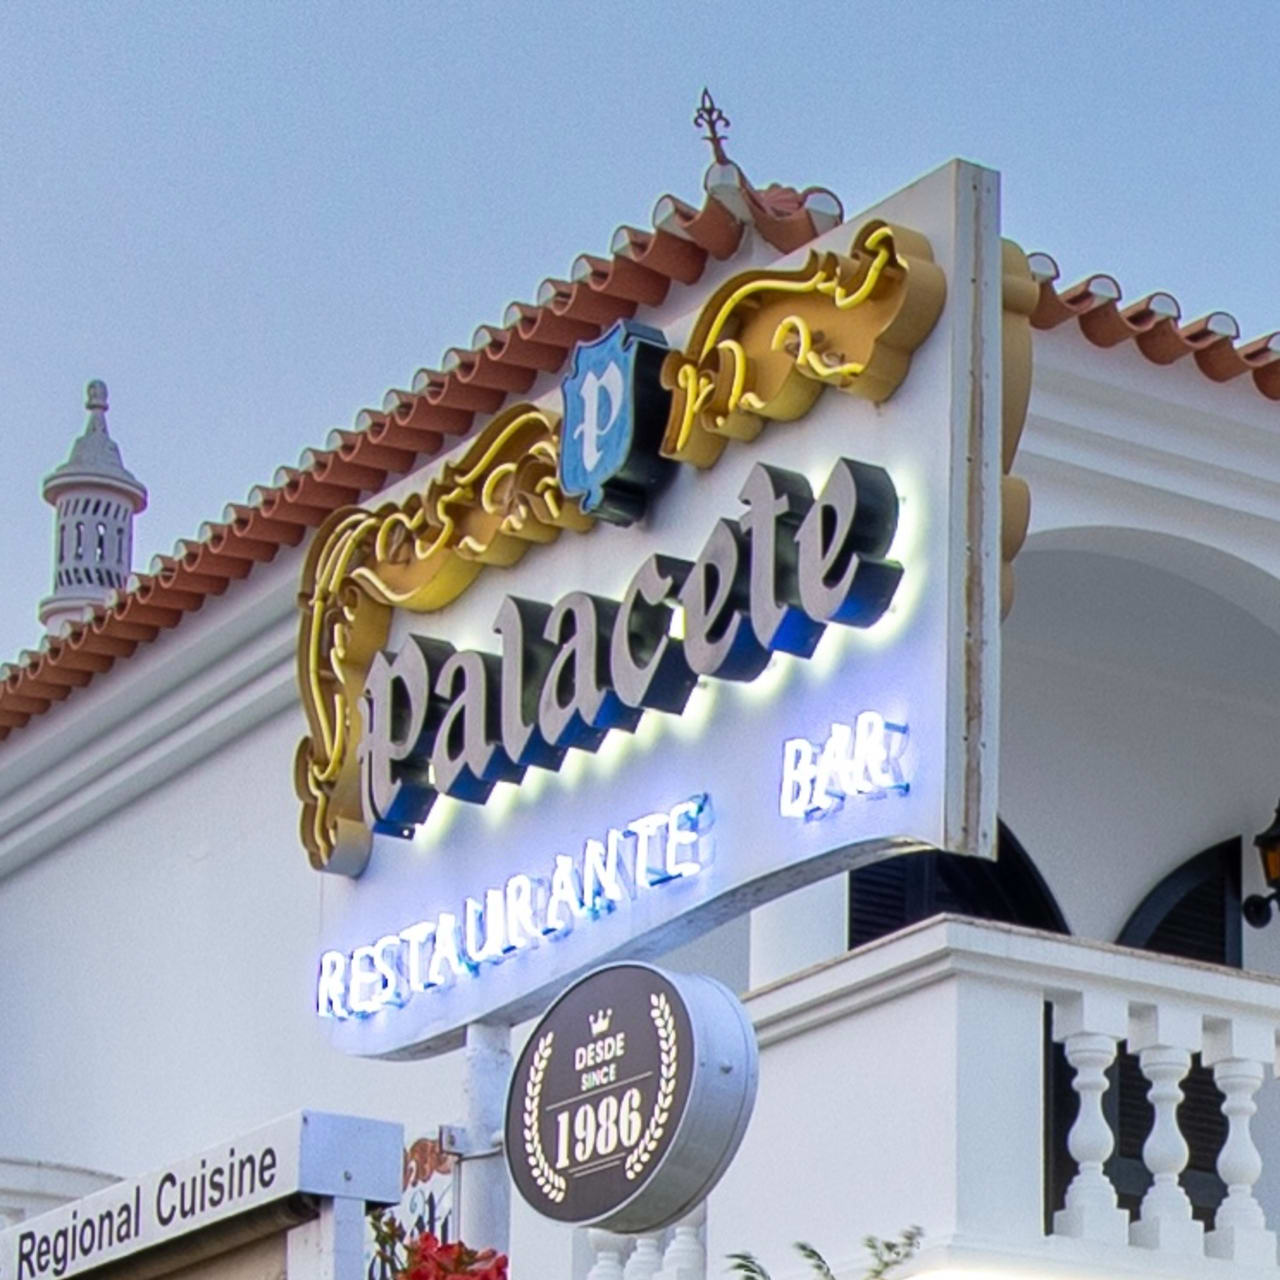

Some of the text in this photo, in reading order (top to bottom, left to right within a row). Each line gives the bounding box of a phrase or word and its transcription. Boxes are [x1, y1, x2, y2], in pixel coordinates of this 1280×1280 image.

[317, 709, 896, 1018] RESTAURANTE BAR
[574, 1031, 626, 1071] DESDE
[580, 1063, 617, 1092] SINCE
[556, 1087, 642, 1169] 1986
[155, 1146, 277, 1227] Cuisine
